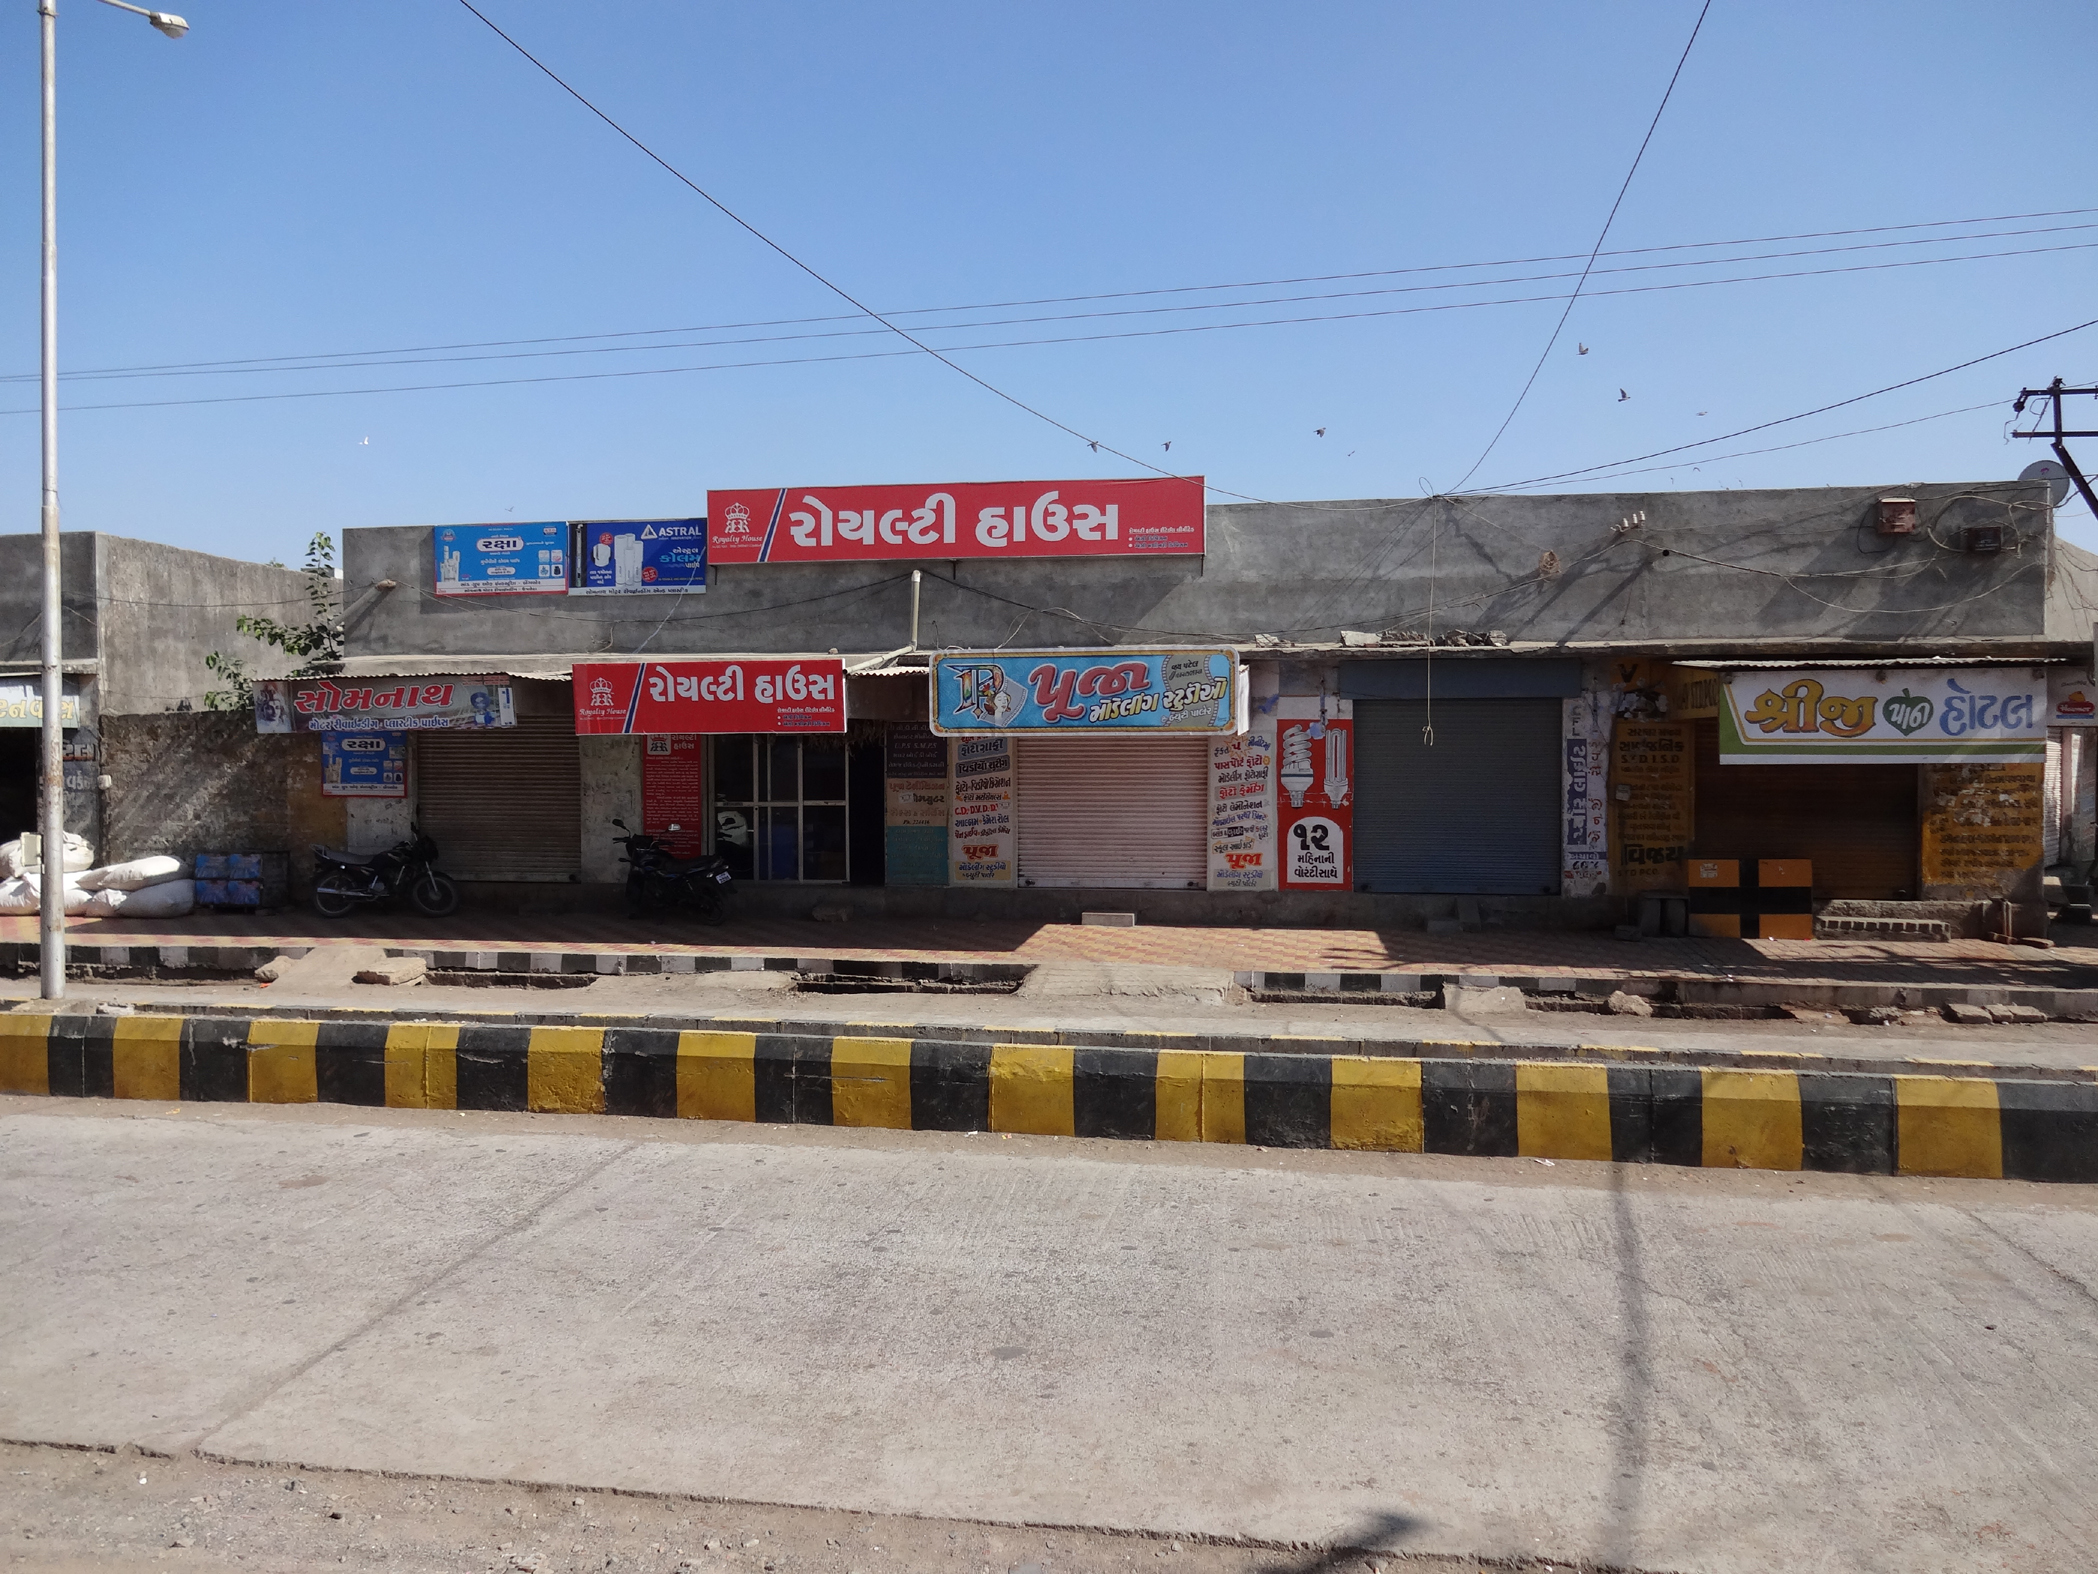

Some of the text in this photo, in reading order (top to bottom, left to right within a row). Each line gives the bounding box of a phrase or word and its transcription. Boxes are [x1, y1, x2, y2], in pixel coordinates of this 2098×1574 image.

[788, 490, 1119, 547] રોયલ્ટી હાઉસ
[659, 525, 702, 537] ASTRAL
[482, 540, 517, 550] રક્ષા
[712, 535, 740, 544] Royalty
[741, 534, 763, 542] House
[649, 664, 835, 704] રોયલ્ટી હાઉસ
[295, 680, 454, 714] સોમનાથ
[1028, 661, 1150, 723] પૂજા
[579, 707, 628, 717] Royalty House
[1745, 678, 1878, 738] શ્રીજી
[1939, 677, 2034, 737] હોટલ
[309, 718, 330, 731] મોટર
[346, 740, 381, 750] રક્ષા
[1293, 823, 1330, 851] ૧૨
[963, 845, 998, 859] પૂજા
[1297, 851, 1335, 865] મહિનાની
[1226, 853, 1263, 869] પૂજા
